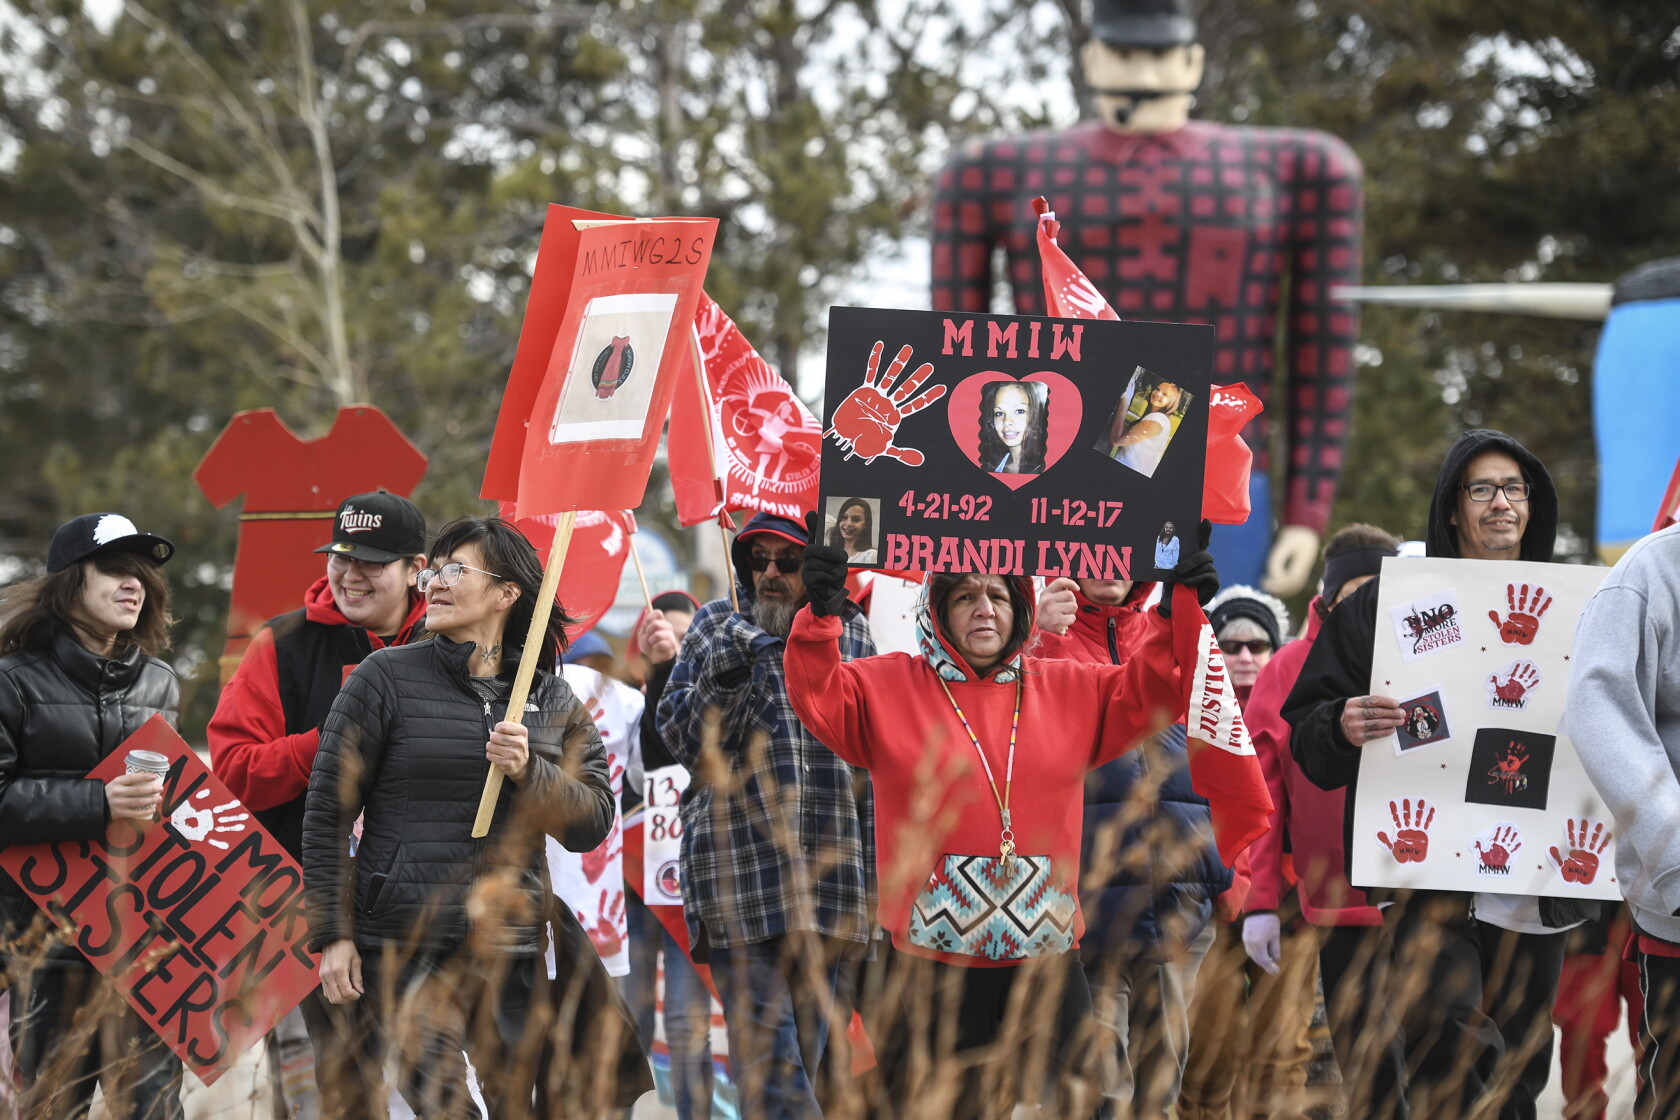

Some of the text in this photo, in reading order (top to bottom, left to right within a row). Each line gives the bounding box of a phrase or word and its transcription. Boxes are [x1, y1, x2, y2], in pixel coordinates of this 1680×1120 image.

[582, 237, 704, 277] MMIWG2S
[941, 318, 1084, 362] MMIW
[729, 492, 801, 518] #MMIW
[898, 490, 1124, 528] 4-21-92 11-12-17
[340, 510, 382, 530] Twins
[884, 532, 1133, 581] BRANDI LYNN
[1420, 604, 1455, 627] NO
[1423, 617, 1457, 635] MORE
[1416, 633, 1462, 654] SISTERS
[1422, 625, 1460, 644] STOLEN
[1492, 696, 1525, 709] MMIW
[1478, 863, 1511, 875] MMIW
